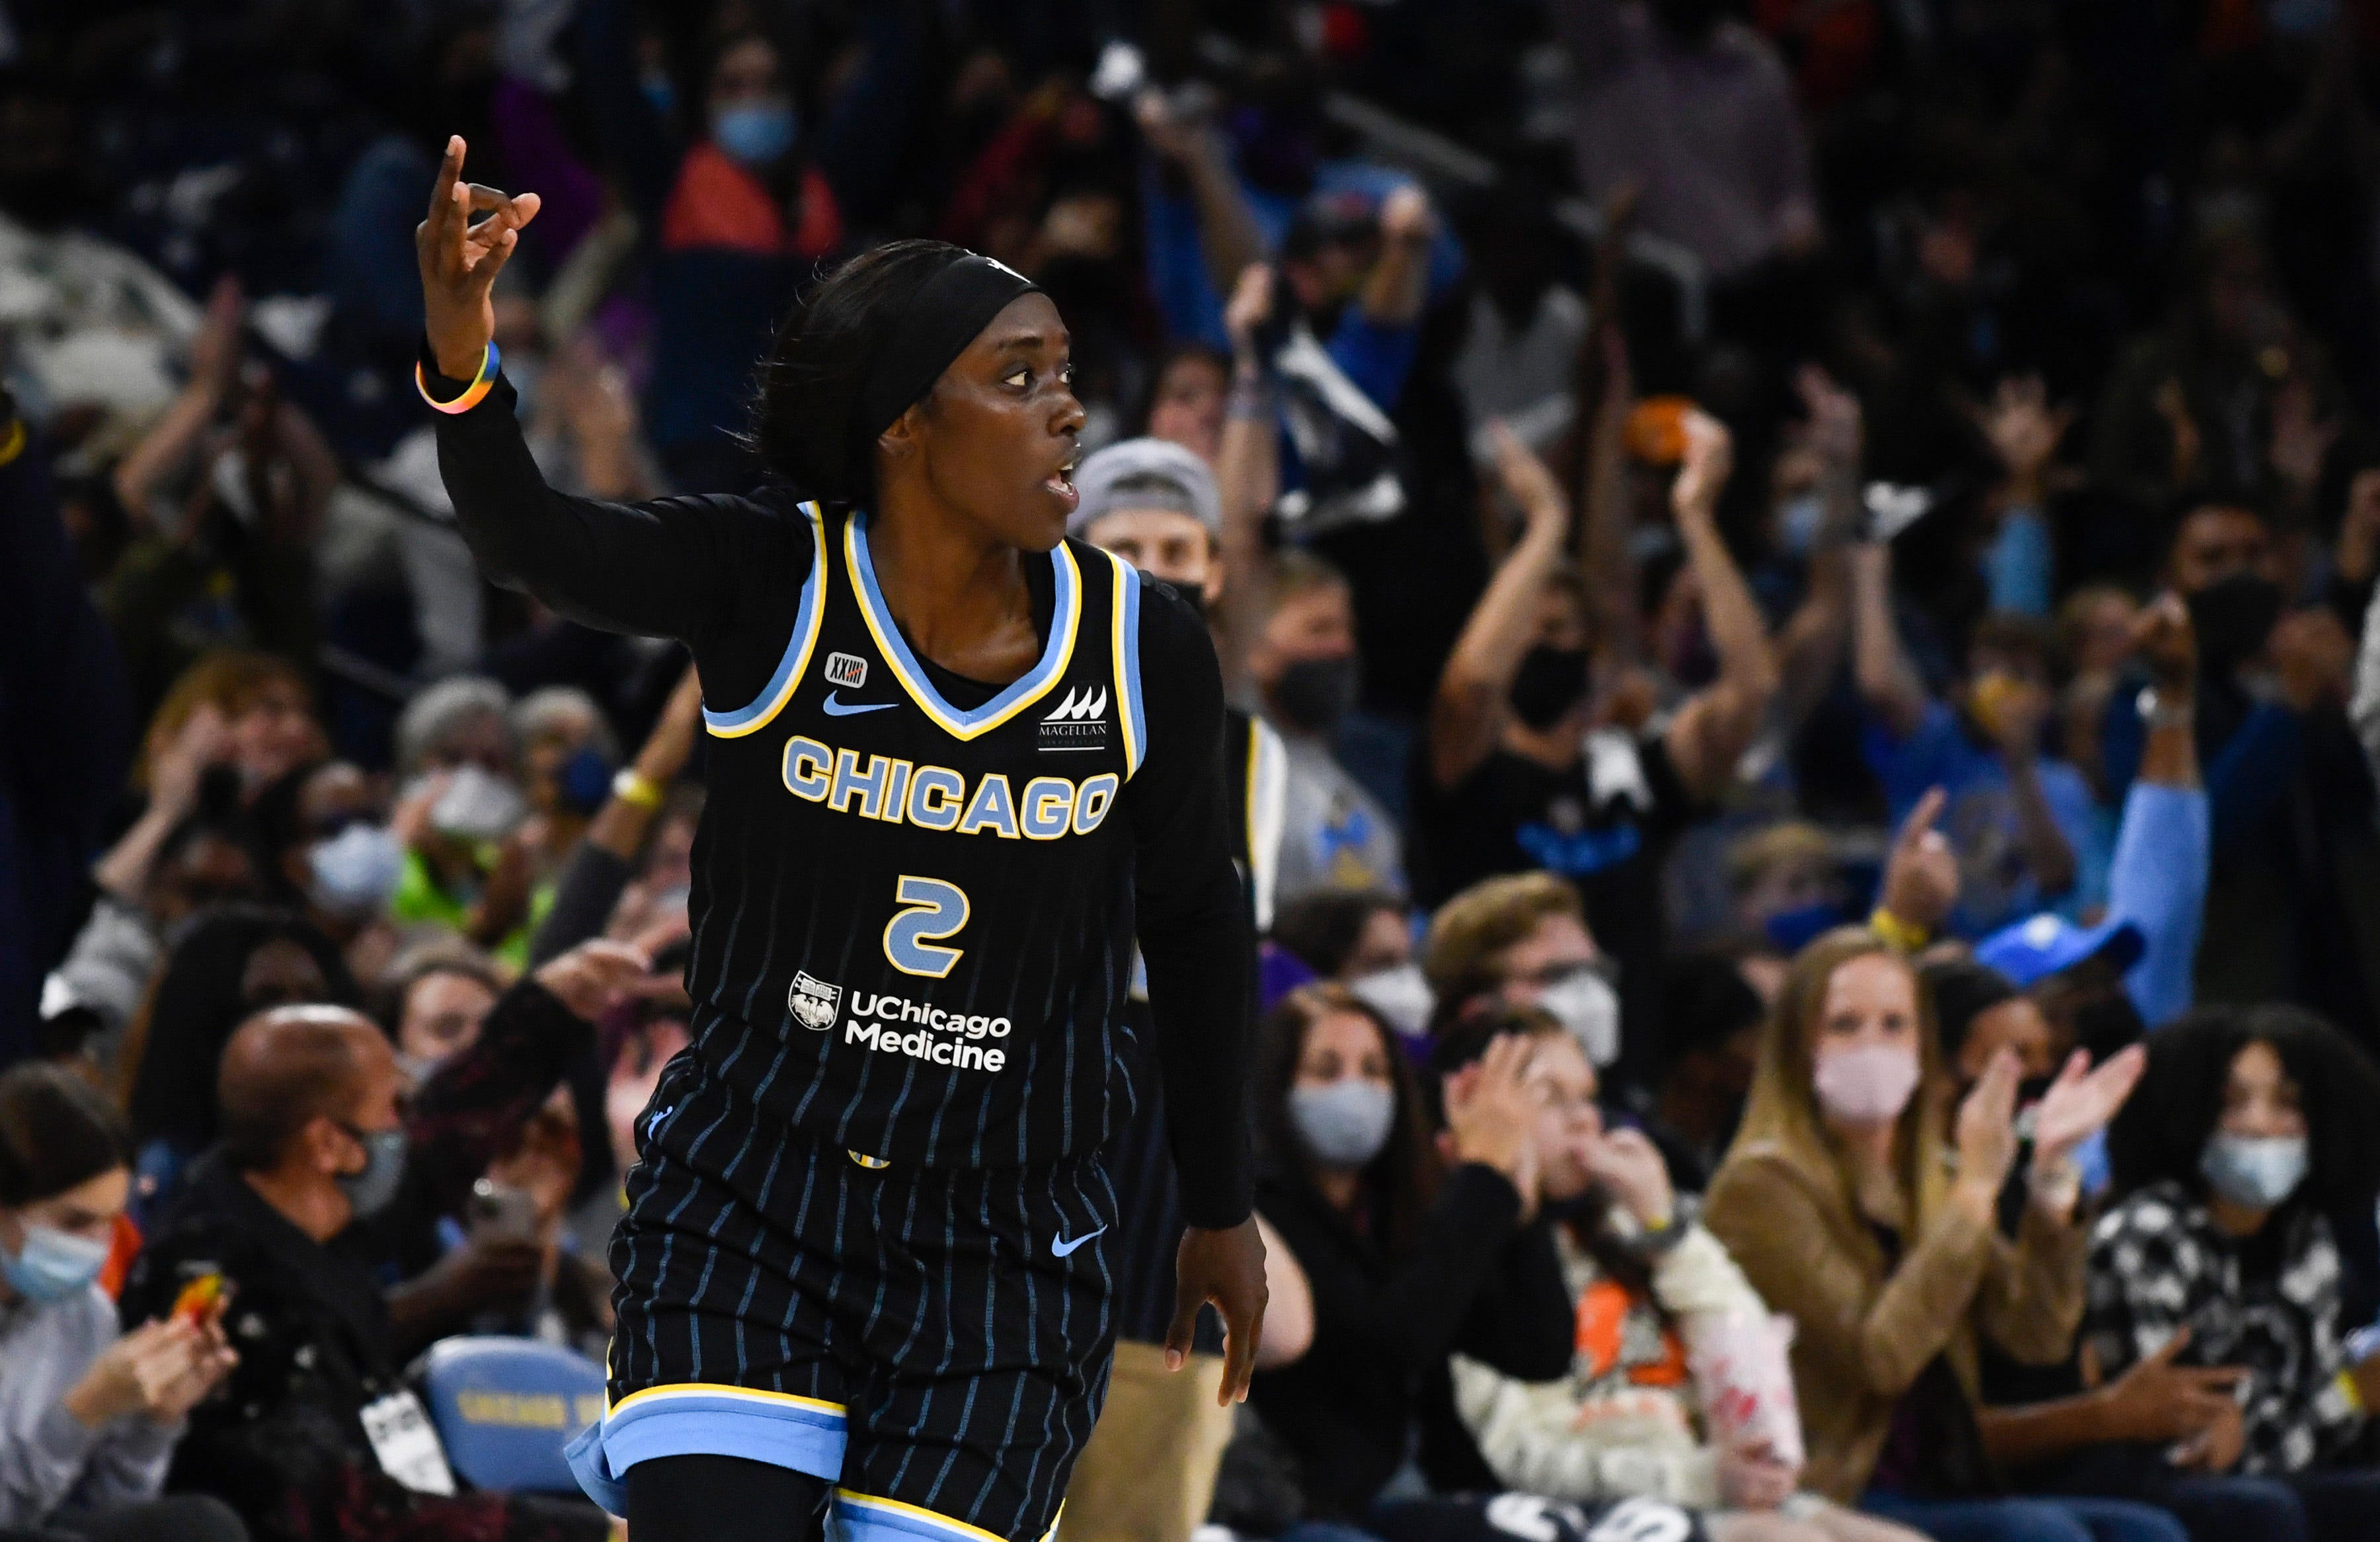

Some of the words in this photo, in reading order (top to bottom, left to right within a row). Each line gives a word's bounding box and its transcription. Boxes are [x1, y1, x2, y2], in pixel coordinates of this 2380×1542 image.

[1039, 725, 1106, 736] MAGELLAN
[782, 735, 1119, 840] CHICAGO
[883, 874, 971, 978] 2
[851, 991, 1011, 1039] UChicago
[845, 1019, 1006, 1072] Medicine
